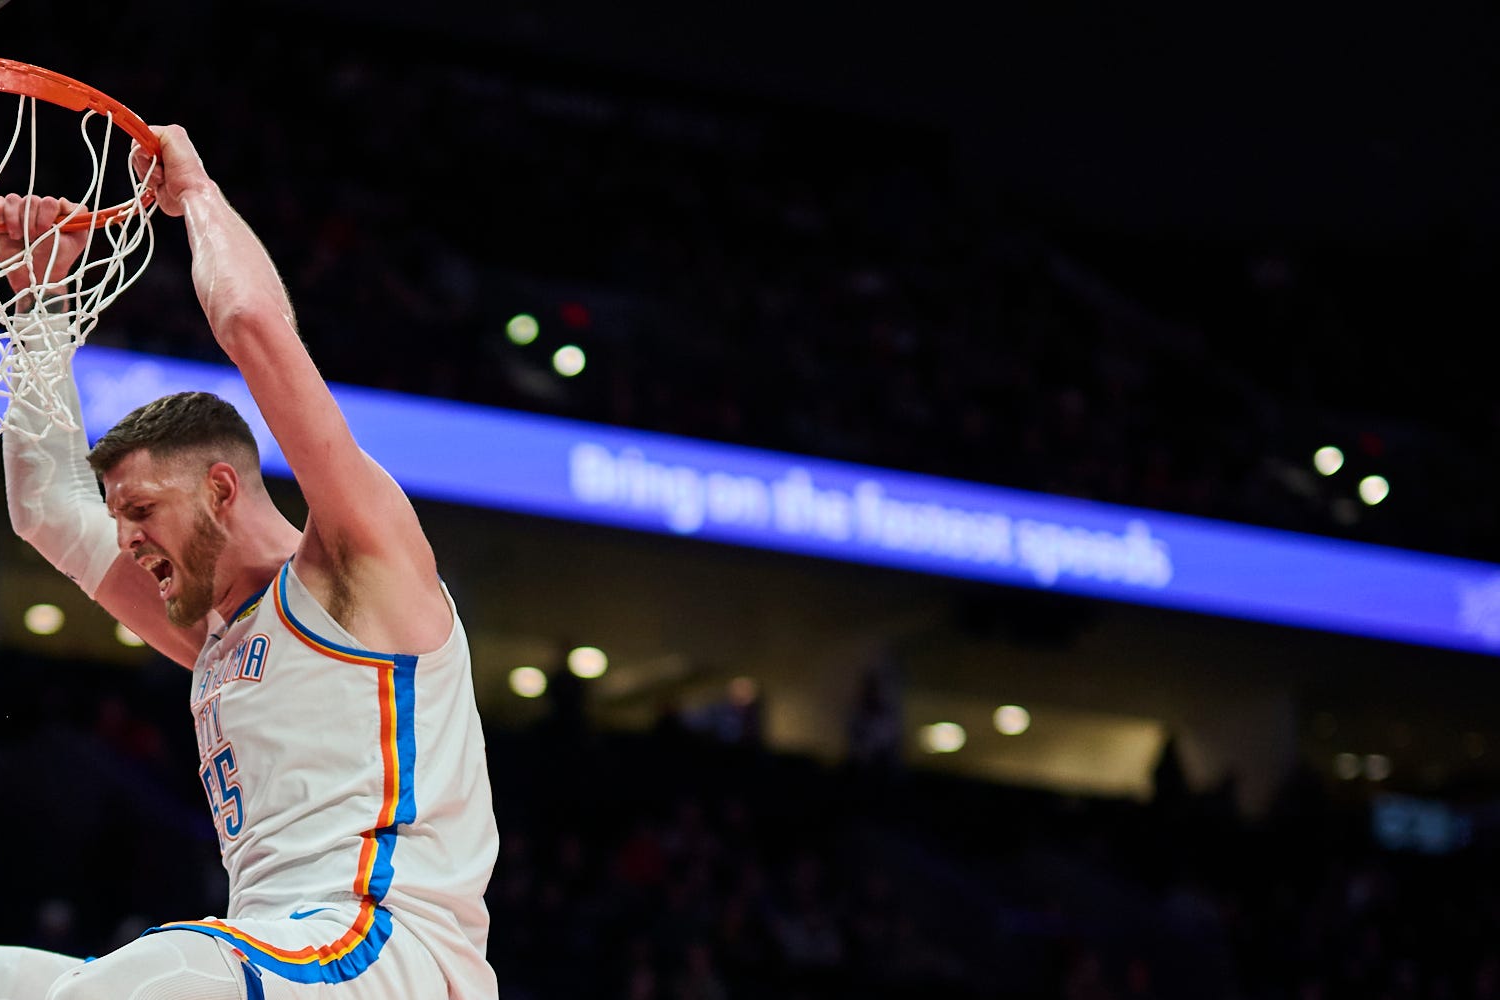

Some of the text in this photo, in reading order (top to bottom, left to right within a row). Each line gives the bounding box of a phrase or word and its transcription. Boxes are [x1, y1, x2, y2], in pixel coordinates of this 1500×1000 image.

[570, 442, 1173, 588] Bring on the fastest speeds
